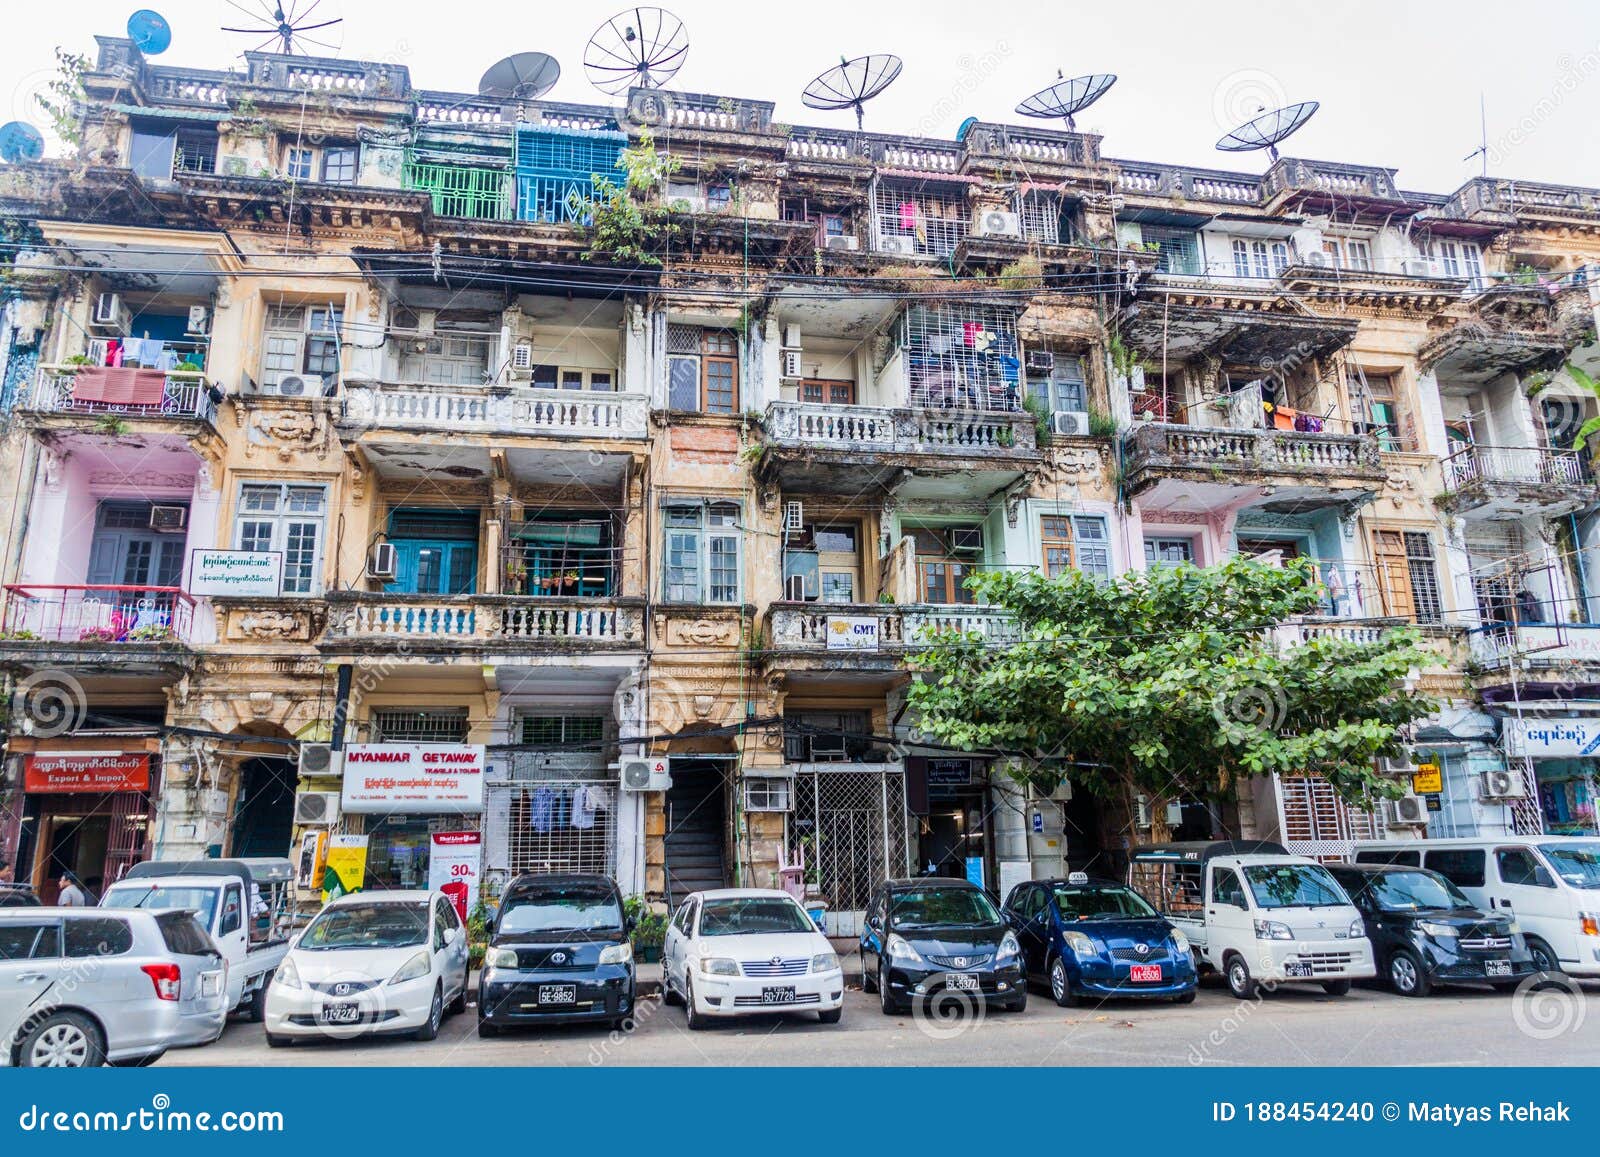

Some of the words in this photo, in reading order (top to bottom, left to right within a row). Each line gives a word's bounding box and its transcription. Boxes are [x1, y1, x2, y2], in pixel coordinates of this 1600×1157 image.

[853, 624, 876, 635] GMT
[348, 752, 410, 763] MYANMAR
[422, 752, 477, 763] GETAWAY
[48, 774, 80, 783] Export
[95, 774, 127, 783] Import
